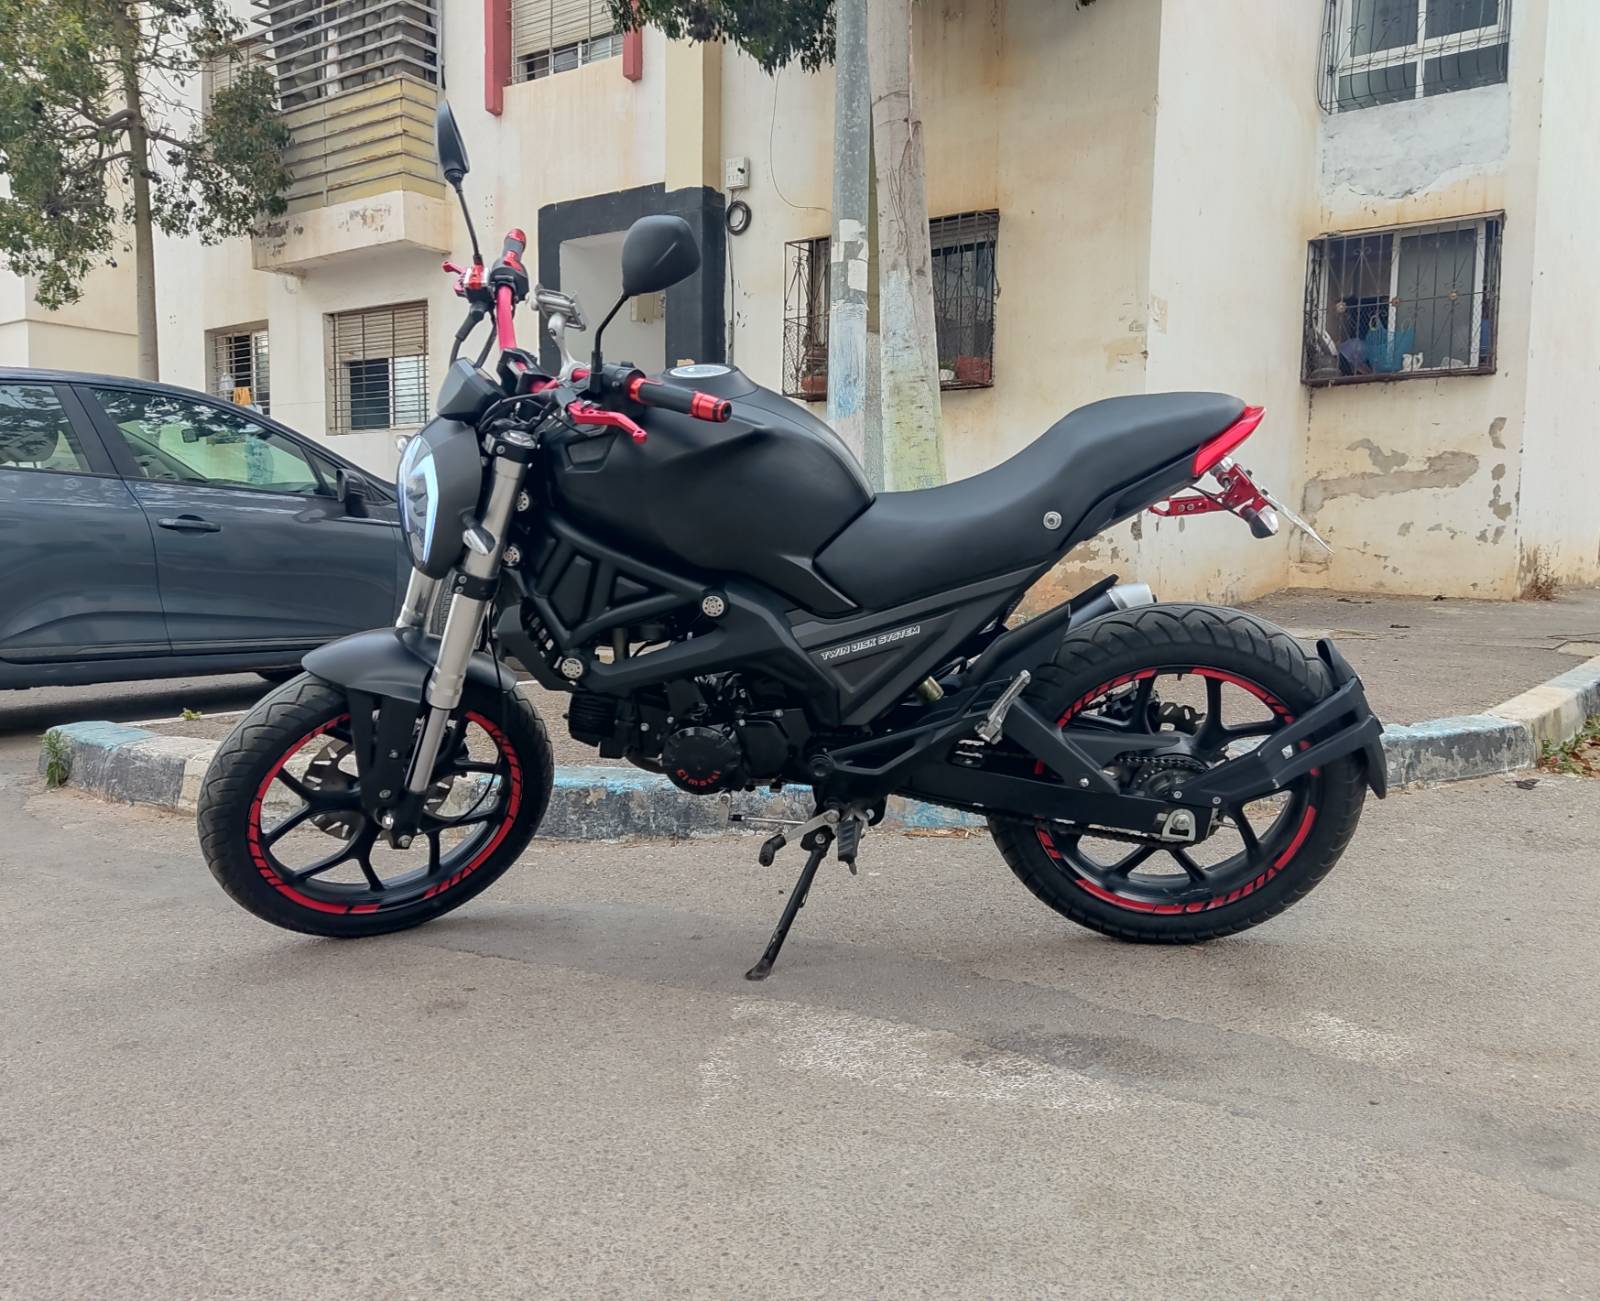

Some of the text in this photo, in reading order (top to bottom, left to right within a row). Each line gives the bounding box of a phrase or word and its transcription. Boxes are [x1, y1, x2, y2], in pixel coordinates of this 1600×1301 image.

[821, 625, 920, 660] TWIN DISK SYSTEM
